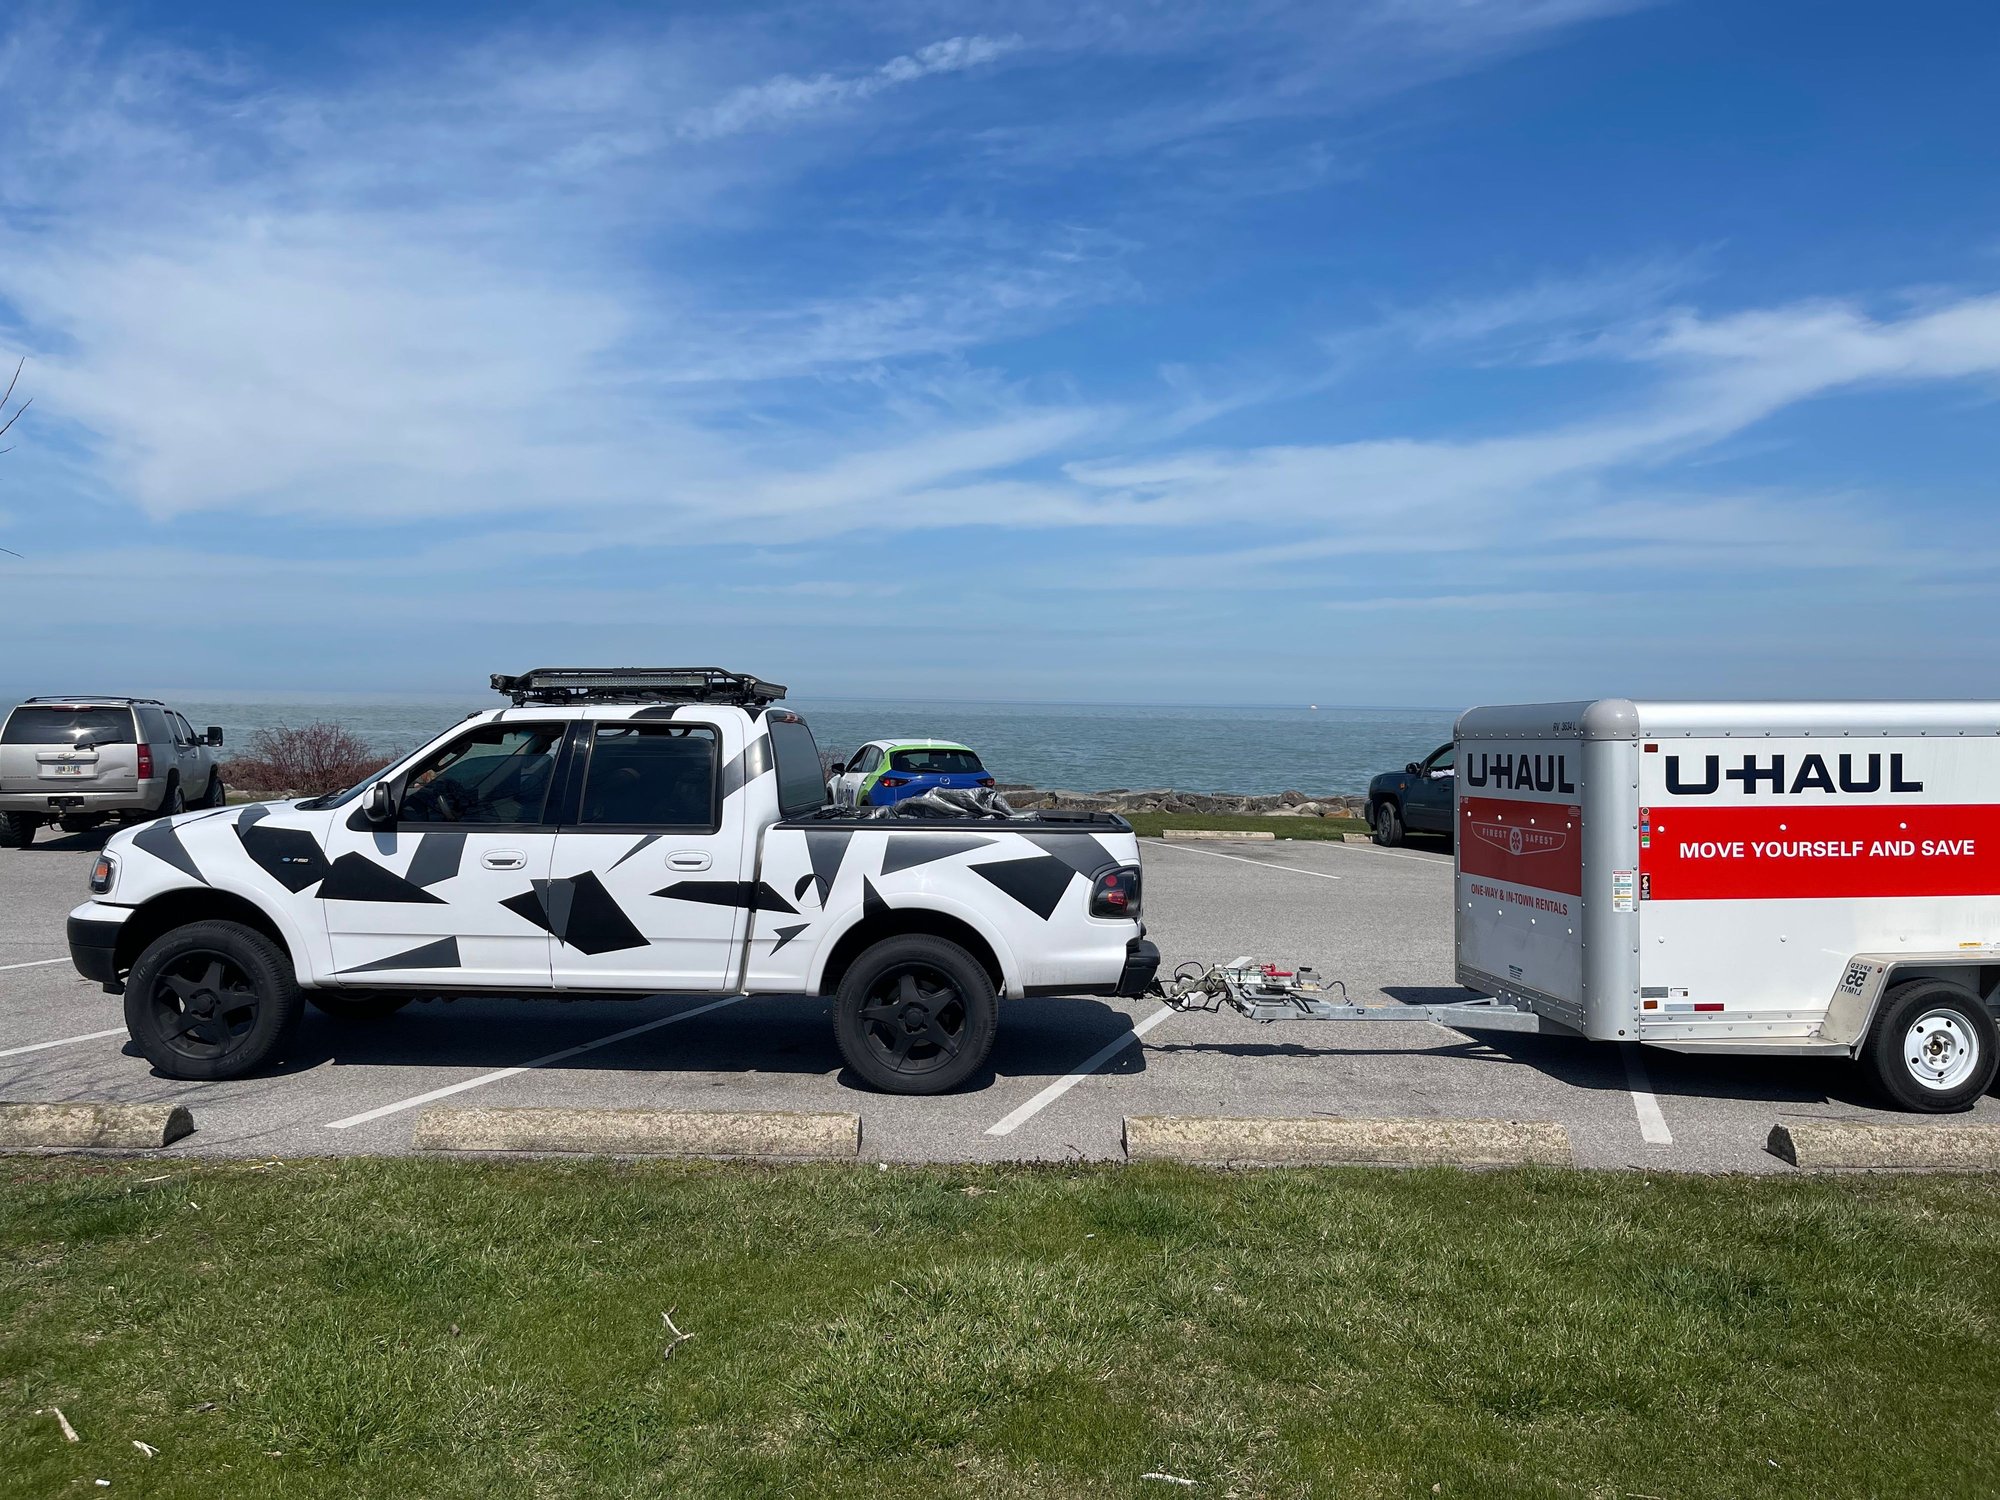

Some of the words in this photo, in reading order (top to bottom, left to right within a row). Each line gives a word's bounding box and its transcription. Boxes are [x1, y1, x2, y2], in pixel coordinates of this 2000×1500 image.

[1468, 753, 1575, 794] U-HAUL
[1665, 753, 1924, 795] U-HAUL
[1482, 828, 1507, 839] FINEST
[1525, 834, 1553, 845] SAFEST
[1679, 842, 1745, 859] MOVE
[1751, 841, 1864, 858] YOURSELF
[1869, 840, 1915, 857] AND
[1921, 840, 1975, 856] SAVE
[1471, 883, 1499, 900] ONE-WAY
[1499, 889, 1504, 901] &
[1506, 891, 1534, 908] IN-TOWN
[1535, 898, 1568, 916] RENTALS
